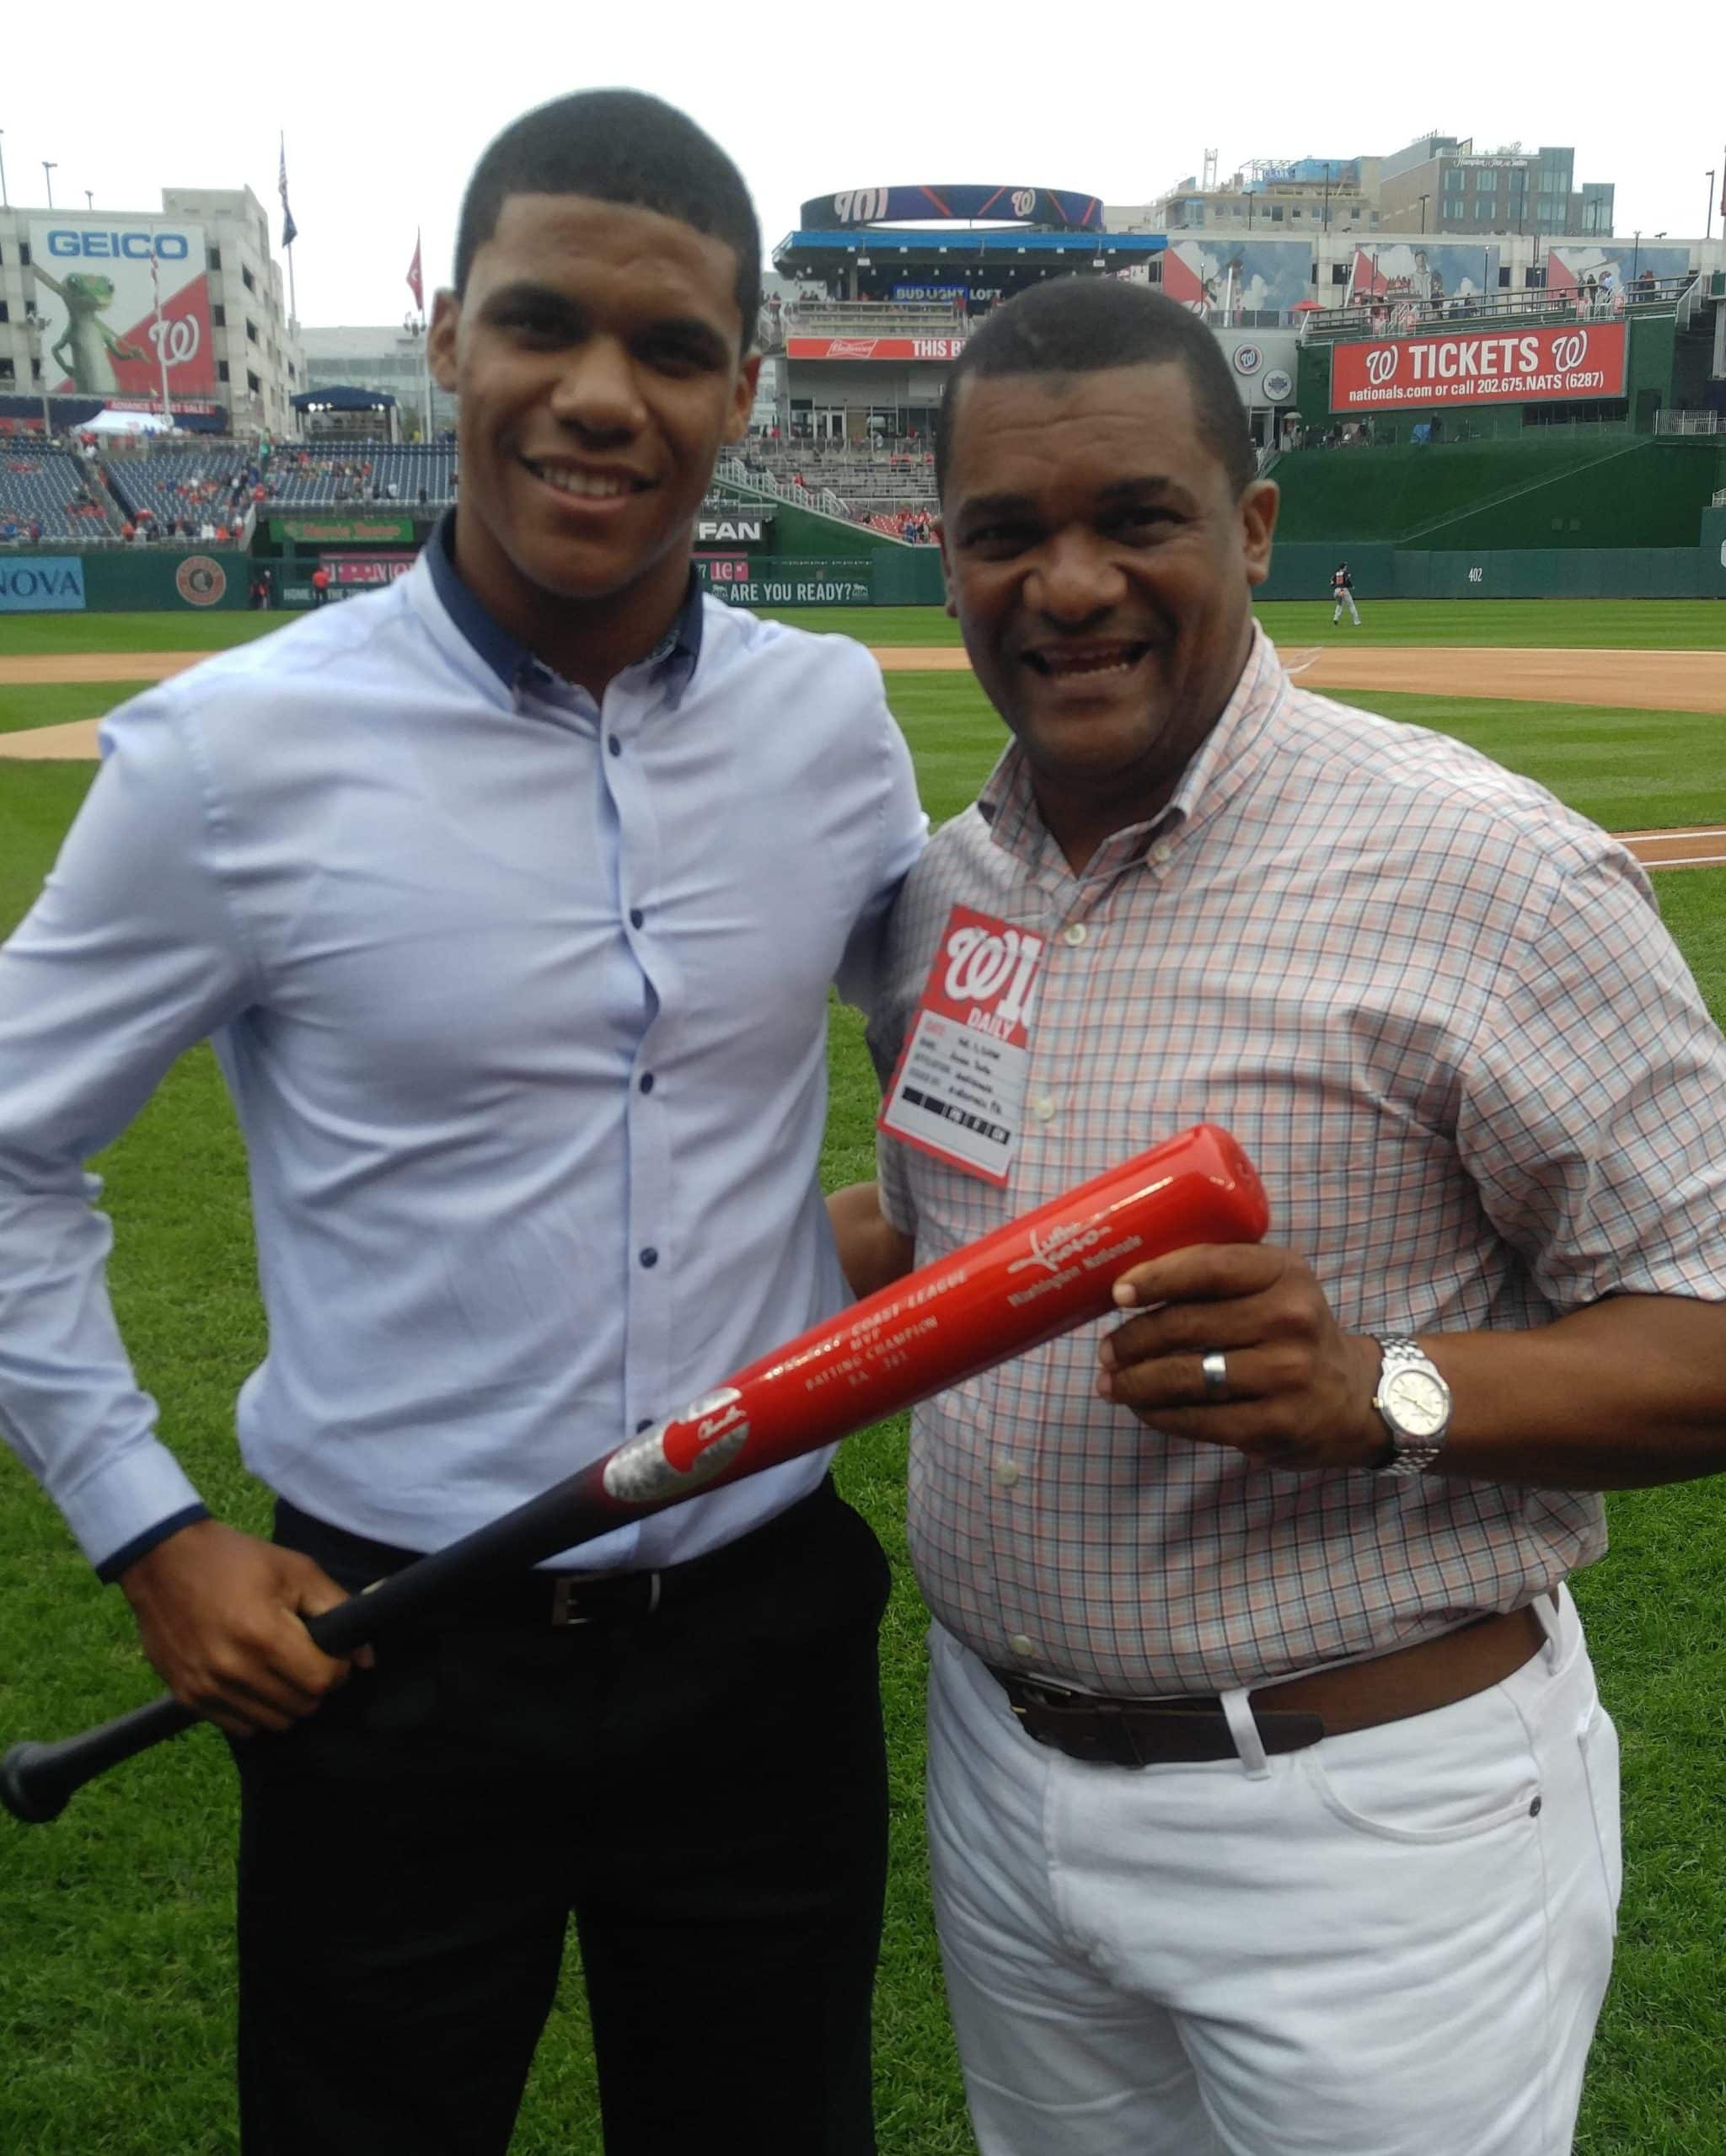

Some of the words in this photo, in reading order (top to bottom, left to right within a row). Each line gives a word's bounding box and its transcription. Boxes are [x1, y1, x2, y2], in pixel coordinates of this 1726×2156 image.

[1011, 189, 1036, 217] W
[47, 230, 188, 260] GEICO
[896, 287, 924, 300] BUD
[926, 287, 964, 300] LIGHT
[969, 287, 1003, 301] LOFT
[148, 314, 200, 366] W
[912, 340, 946, 357] THIS
[951, 340, 967, 356] B
[1366, 345, 1398, 384] W
[1409, 336, 1539, 379] TICKETS
[1552, 330, 1588, 373] W
[1349, 385, 1432, 402] nationals.com
[1435, 384, 1448, 396] or
[1450, 380, 1474, 394] call
[1477, 373, 1563, 394] 202.675.NATS
[1566, 370, 1604, 391] (6287)
[699, 522, 760, 540] FAN
[1468, 568, 1482, 582] 402
[730, 583, 758, 601] ARE
[763, 583, 791, 601] YOU
[797, 583, 851, 601] READY?
[945, 925, 1021, 1001] W
[967, 1006, 1014, 1039] DAILY
[866, 1315, 938, 1360] CHAMPION
